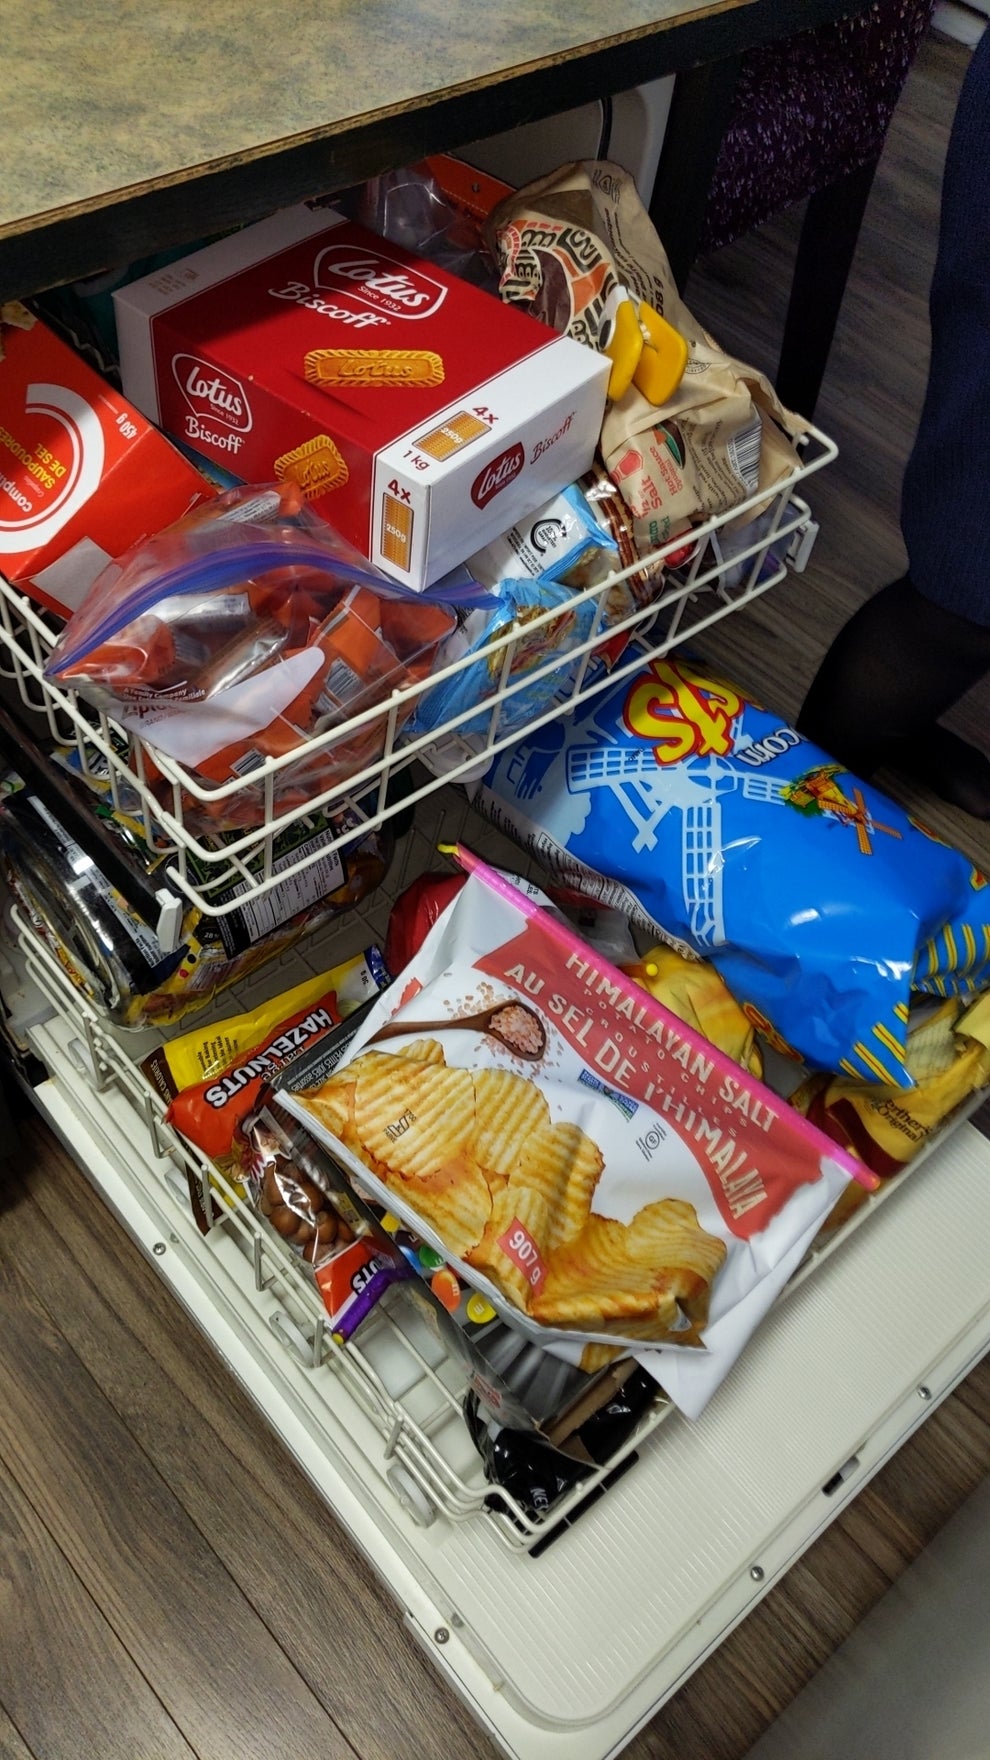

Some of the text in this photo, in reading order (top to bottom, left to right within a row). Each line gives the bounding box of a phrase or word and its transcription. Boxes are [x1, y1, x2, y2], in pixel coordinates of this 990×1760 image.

[328, 259, 430, 308] Lotus
[268, 281, 388, 329] Biscoff
[381, 296, 402, 312] 1932
[337, 358, 413, 379] Lotus
[185, 366, 243, 416] Lotus
[116, 413, 138, 440] 450 g
[185, 415, 243, 454] Biscoff
[472, 405, 499, 425] 4x
[530, 415, 573, 465] Biscoff
[34, 443, 67, 480] DE SEL
[410, 454, 431, 472] kg
[477, 451, 523, 500] Lotus
[649, 446, 669, 478] Sauce
[387, 478, 412, 504] 4x
[641, 475, 663, 511] Salt
[663, 475, 679, 497] Hot
[154, 687, 188, 700] Company
[503, 962, 545, 997] AU
[547, 994, 599, 1048] SEL
[593, 1041, 638, 1091] DE
[564, 952, 716, 1083] HIMALAYAN
[719, 1074, 781, 1133] SALT
[582, 988, 667, 1060] POTATO
[205, 1007, 333, 1109] HAZELNUTS
[877, 1103, 924, 1143] Original
[885, 1098, 933, 1138] erther's
[508, 1229, 542, 1287] 907 g
